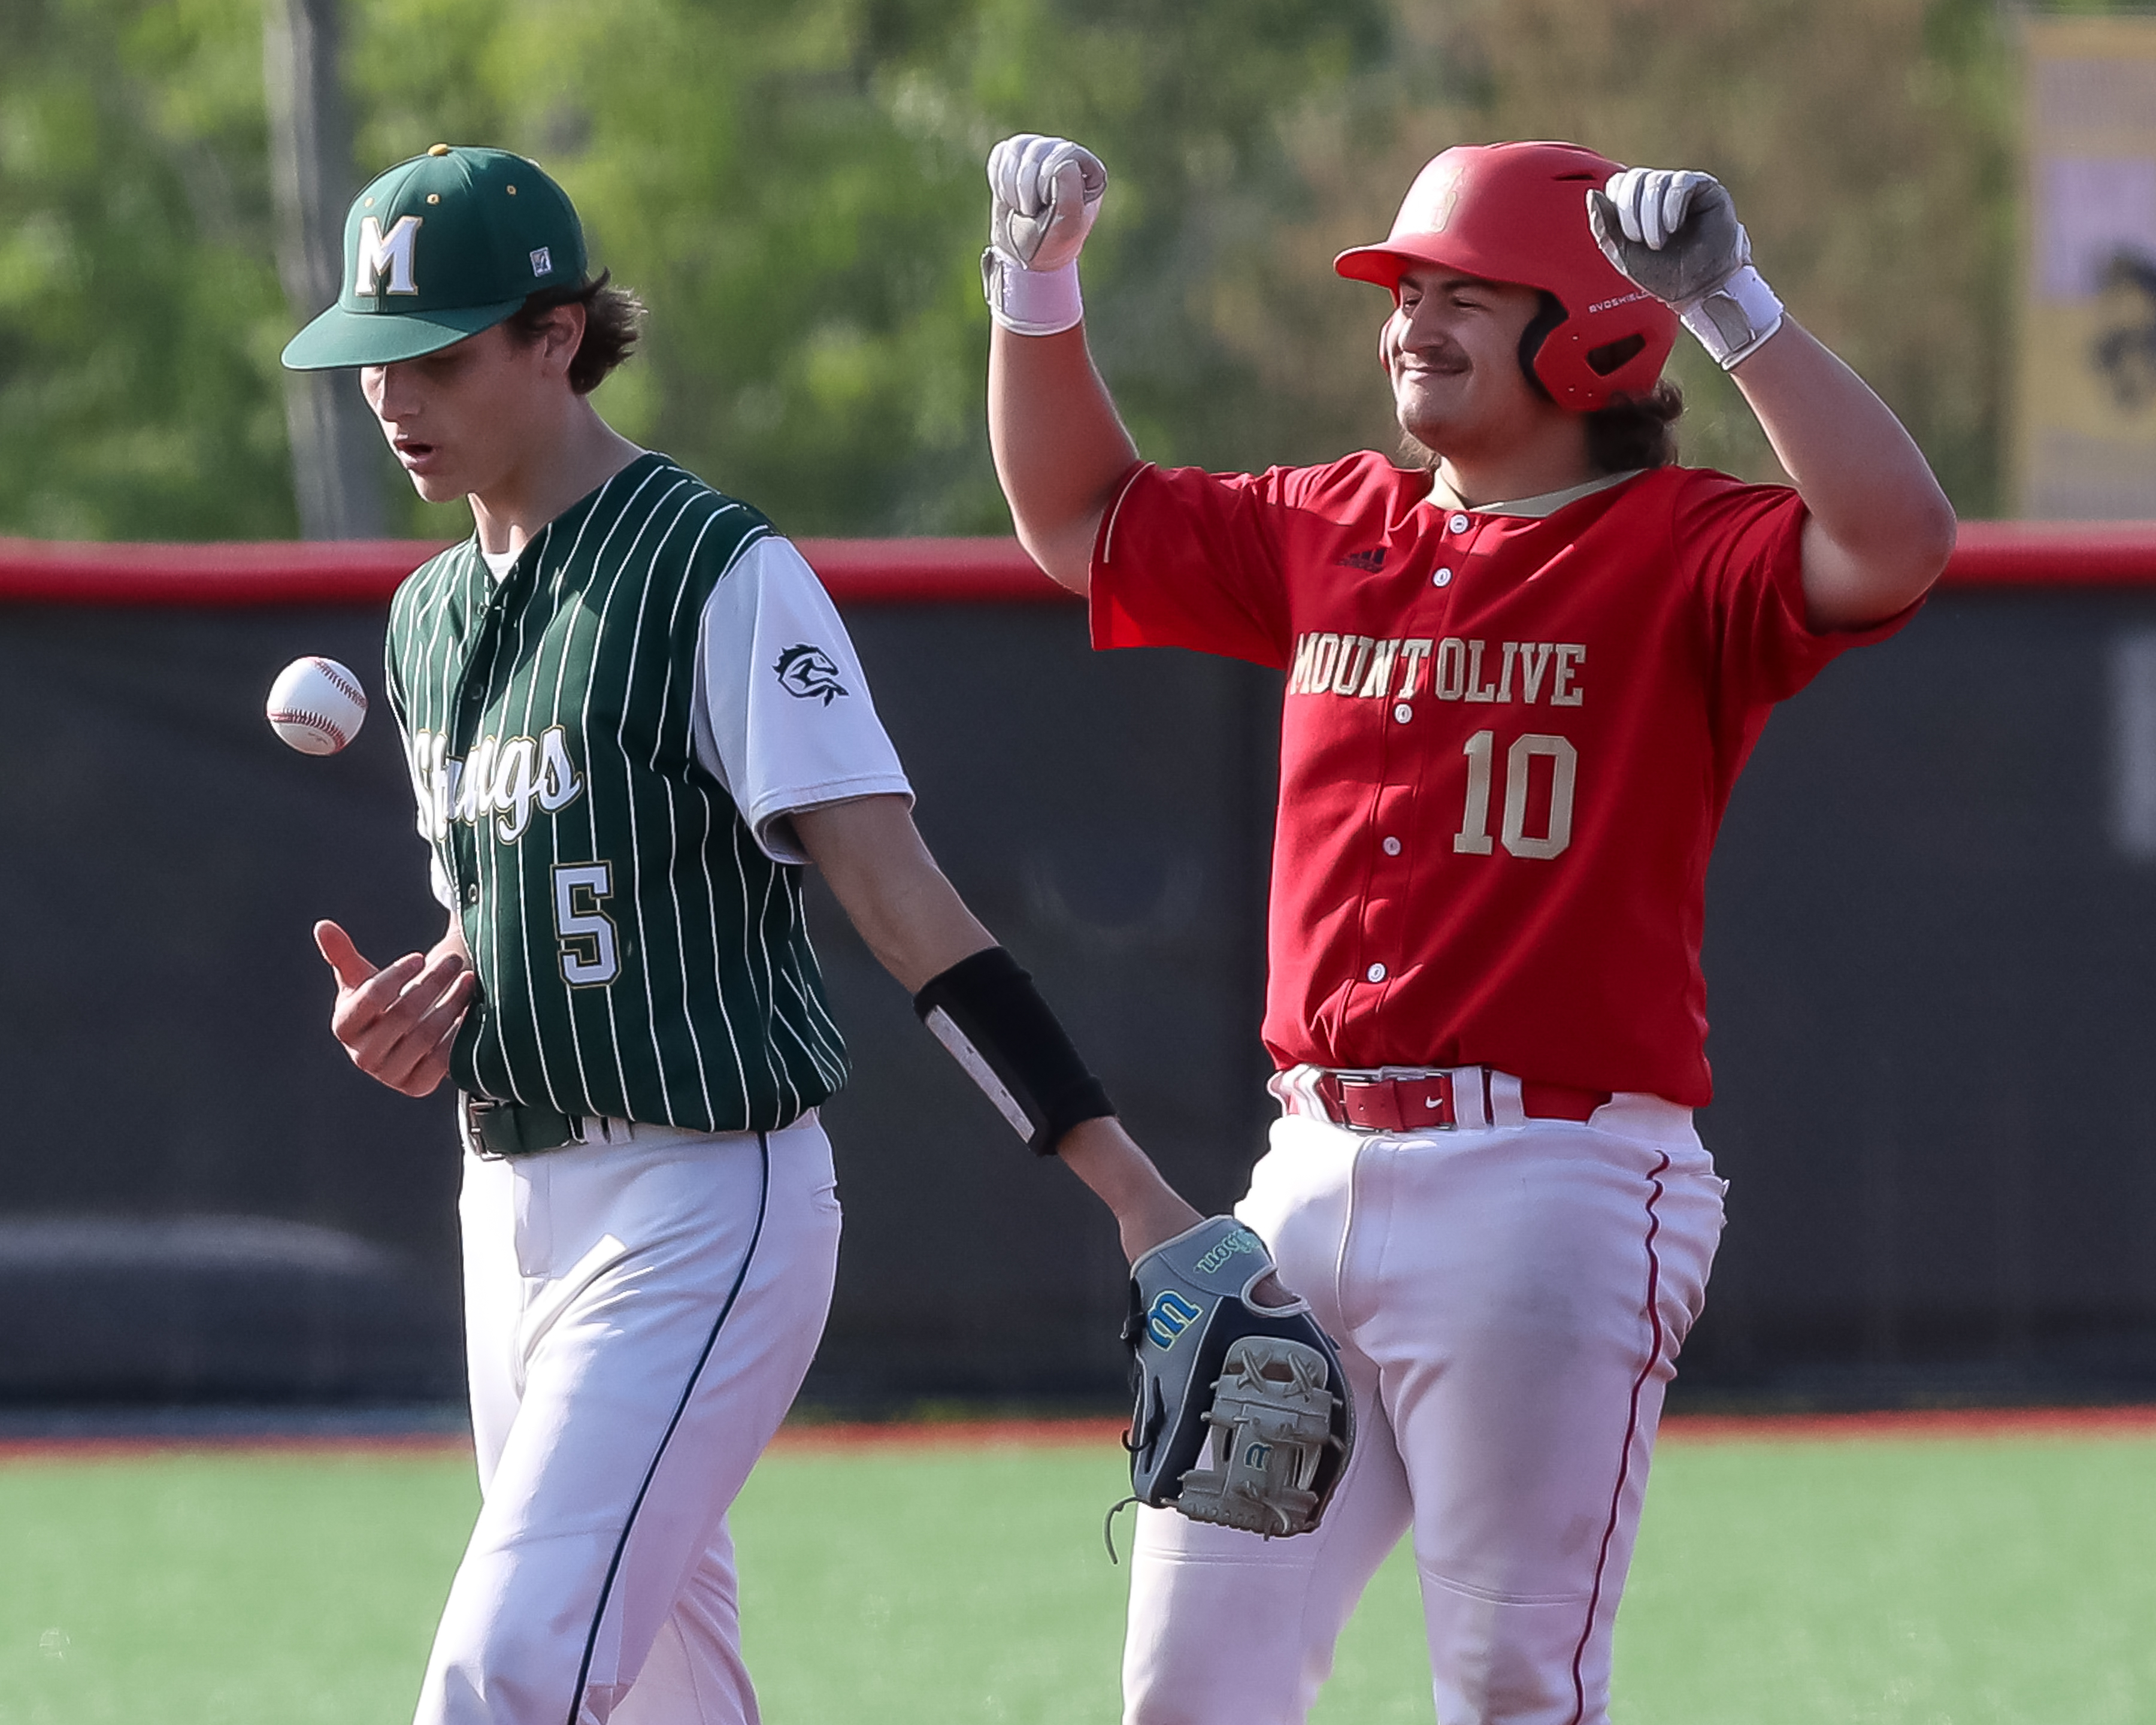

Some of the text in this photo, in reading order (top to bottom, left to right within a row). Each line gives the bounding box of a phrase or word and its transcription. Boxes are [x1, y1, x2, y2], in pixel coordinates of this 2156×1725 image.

[355, 216, 423, 296] M
[1290, 632, 1586, 706] MOUNT OLIVE
[1454, 731, 1577, 860] 10
[550, 860, 621, 989] 5
